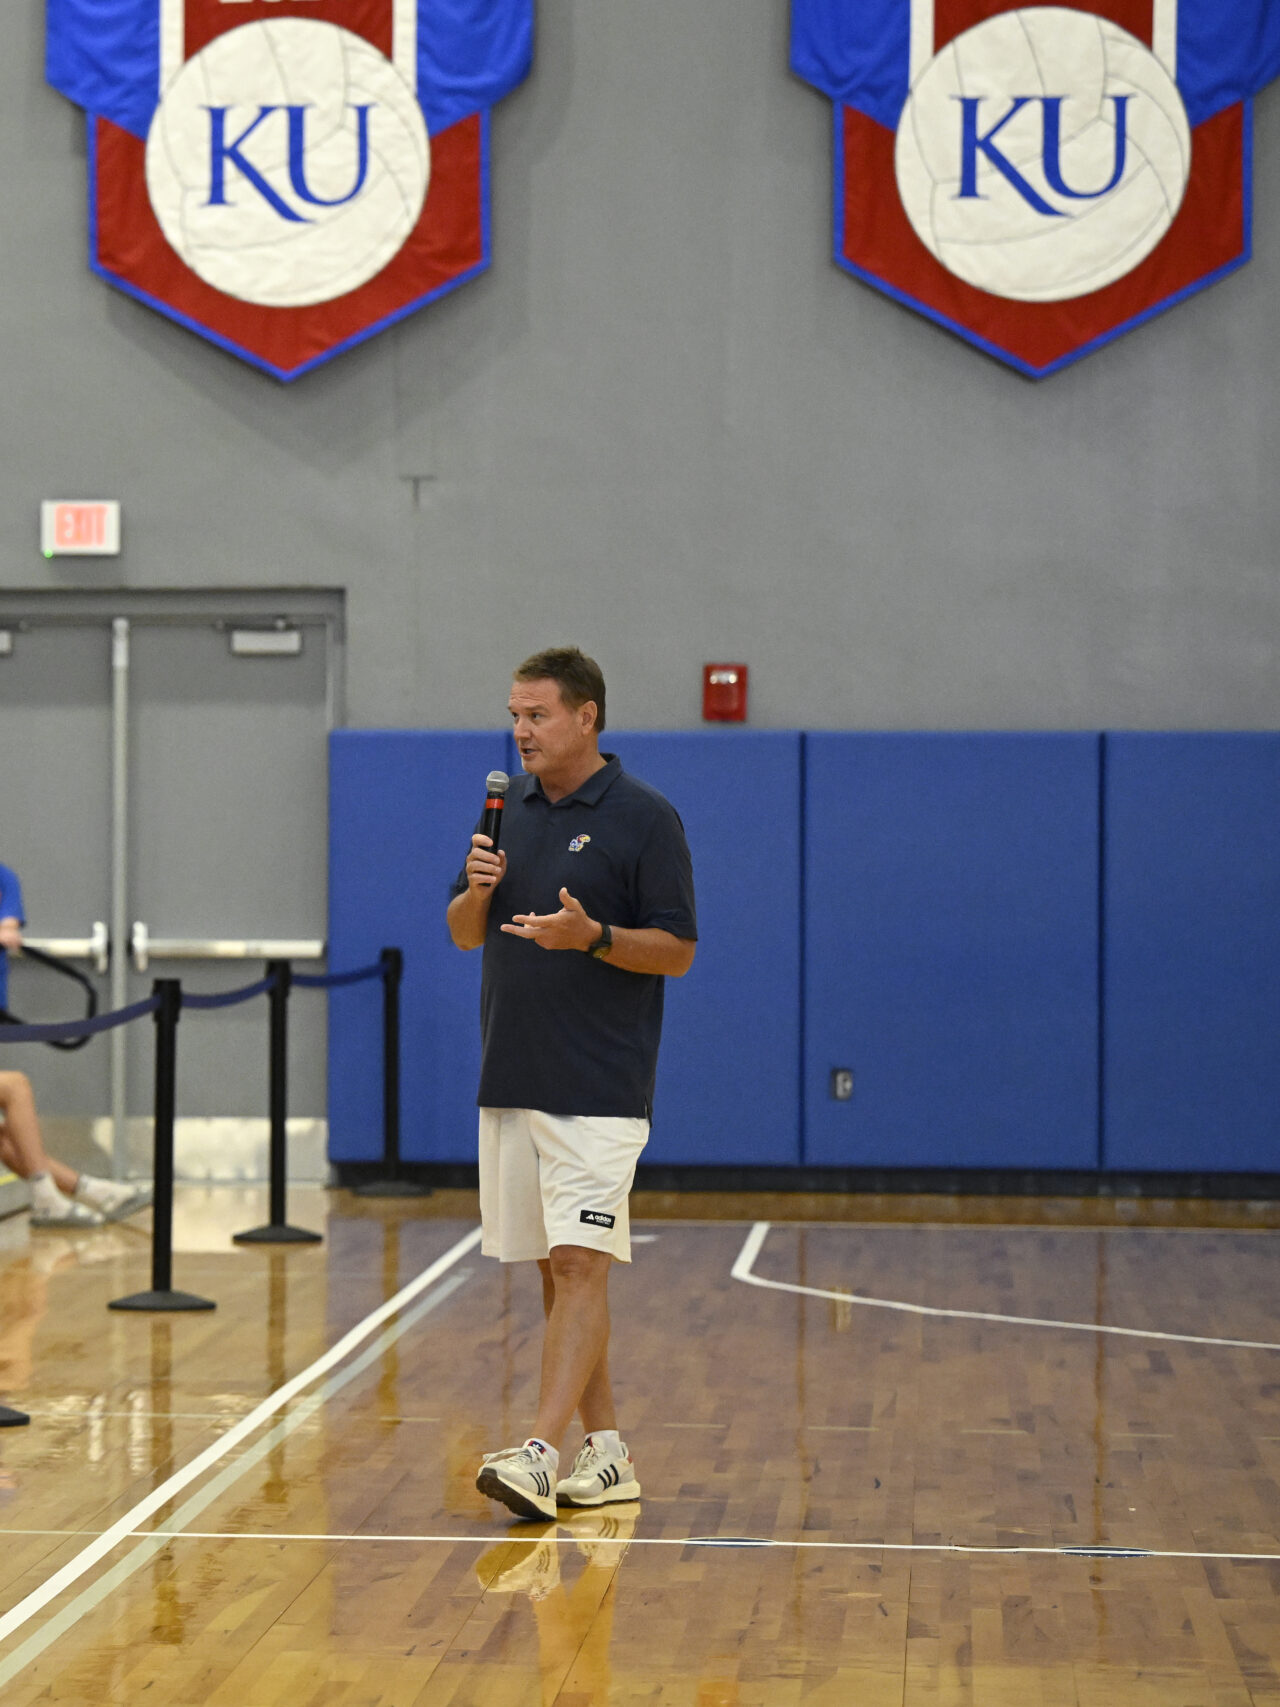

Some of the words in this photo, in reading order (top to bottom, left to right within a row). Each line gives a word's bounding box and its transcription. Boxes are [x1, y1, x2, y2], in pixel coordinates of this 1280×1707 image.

[198, 104, 378, 224] KU
[949, 94, 1138, 219] KU
[55, 504, 108, 547] EXIT
